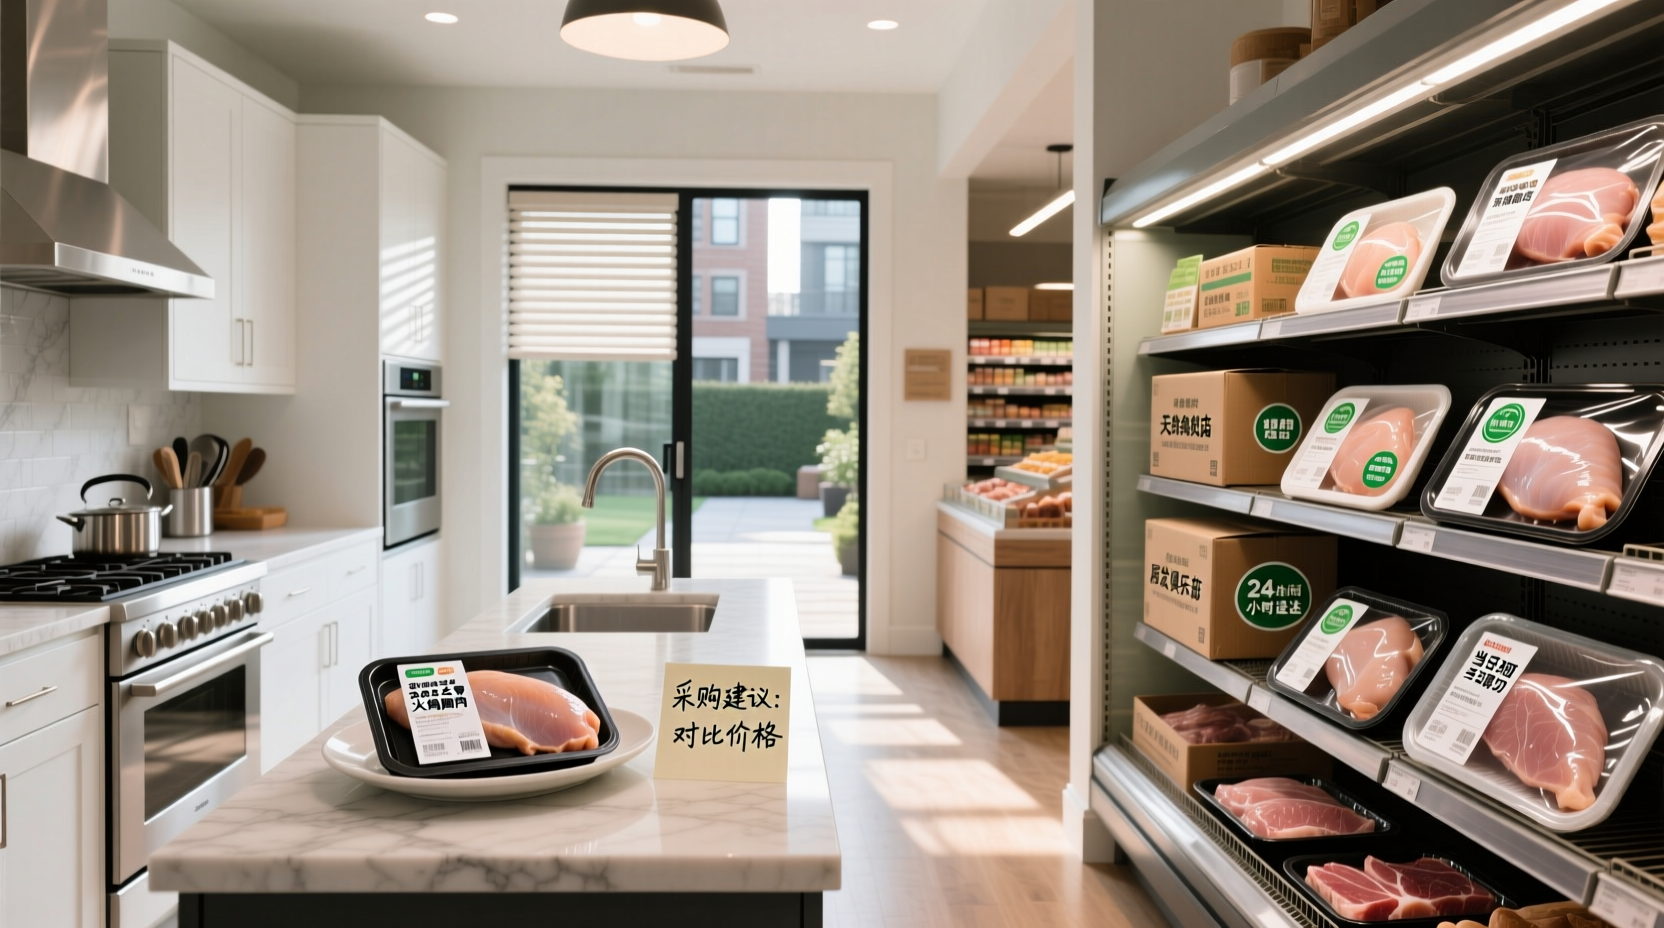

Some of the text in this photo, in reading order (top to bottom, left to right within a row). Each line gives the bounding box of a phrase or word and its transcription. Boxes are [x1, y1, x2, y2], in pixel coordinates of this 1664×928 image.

[672, 678, 780, 712] 采购建议:
[673, 720, 783, 753] 对比价格
